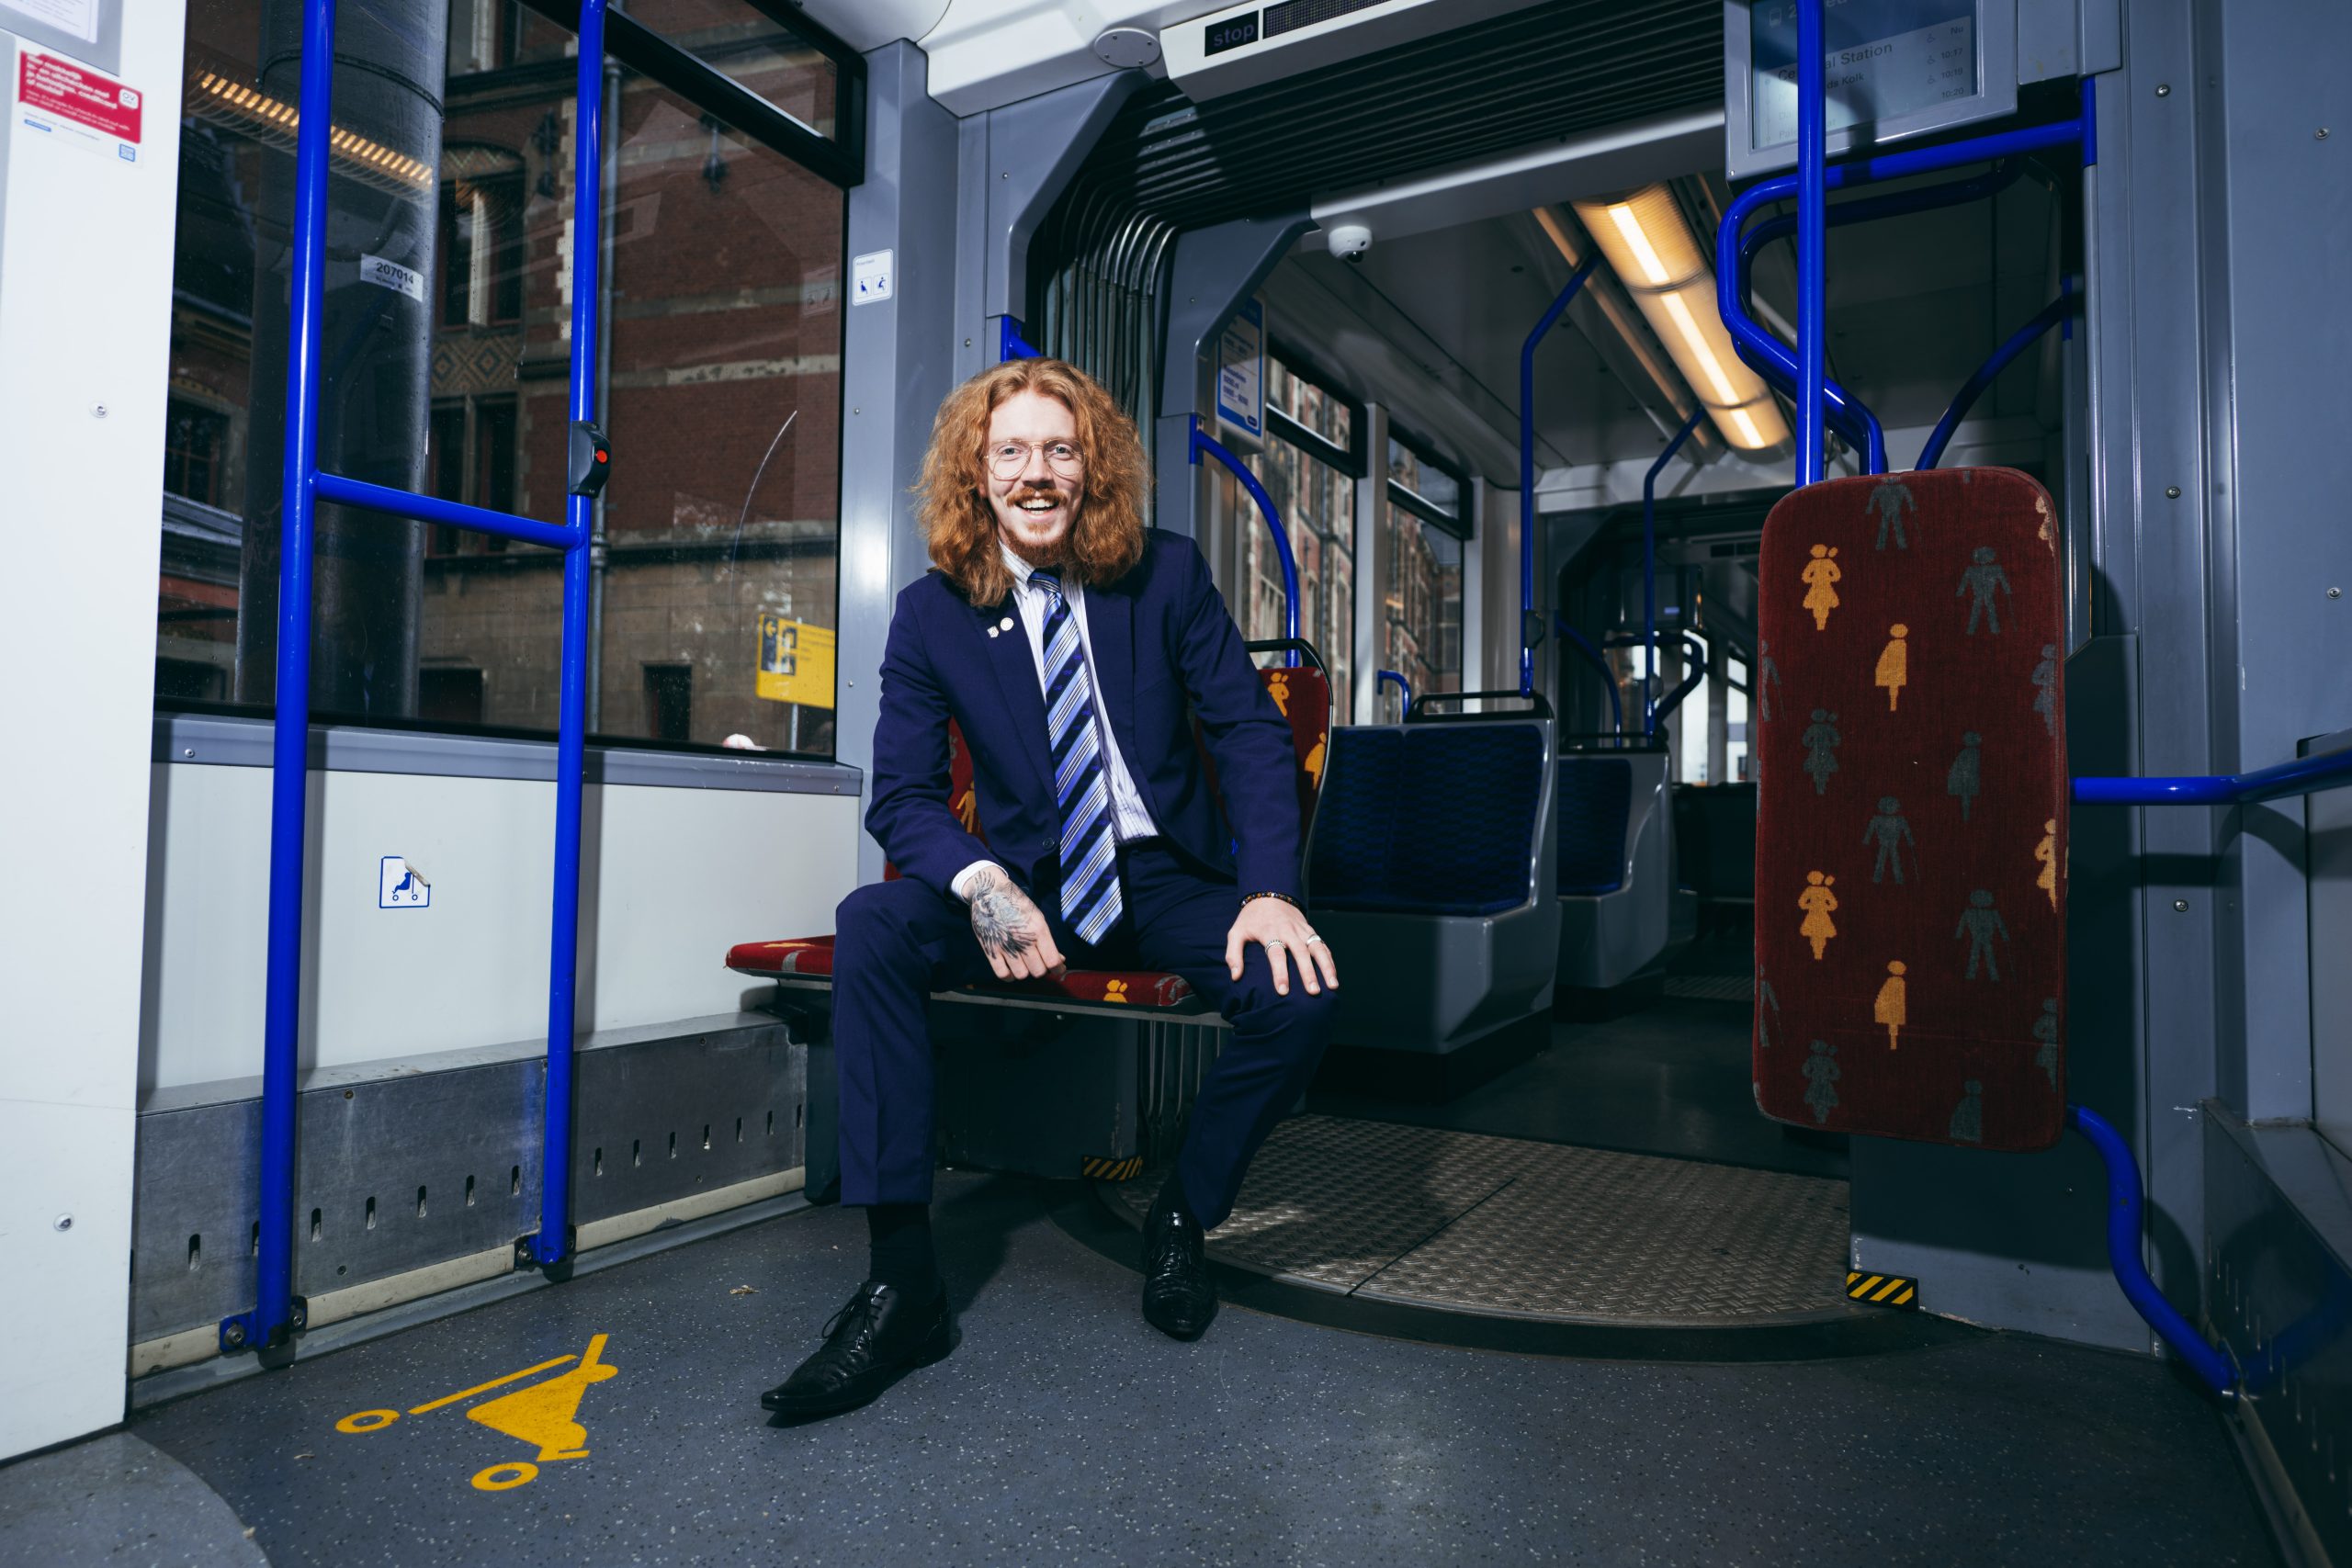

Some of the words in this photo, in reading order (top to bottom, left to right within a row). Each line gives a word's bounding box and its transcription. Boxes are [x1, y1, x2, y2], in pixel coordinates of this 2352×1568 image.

[1213, 22, 1255, 47] stop
[1840, 43, 1893, 65] Station
[1841, 72, 1865, 85] Kolk
[376, 262, 413, 284] 207014
